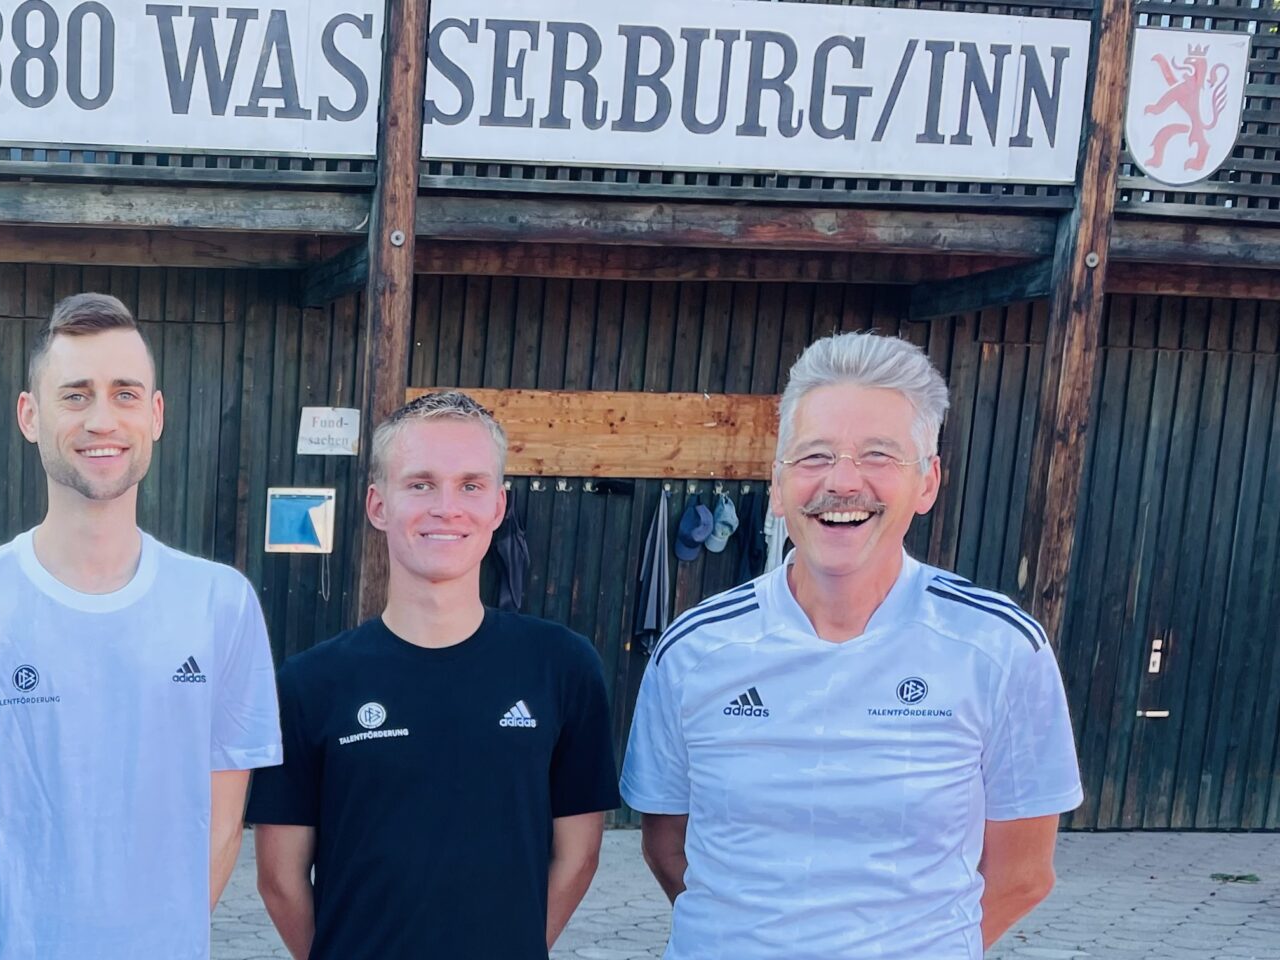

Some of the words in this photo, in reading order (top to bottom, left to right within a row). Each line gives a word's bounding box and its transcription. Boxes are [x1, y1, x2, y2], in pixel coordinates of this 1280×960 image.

[311, 416, 349, 429] Fund-
[172, 672, 207, 683] adidas
[723, 705, 770, 718] adidas
[868, 708, 952, 717] TALENTFÖRDERUNG
[499, 716, 537, 728] adidas
[339, 728, 409, 745] TALENTFÖRDERUNG
